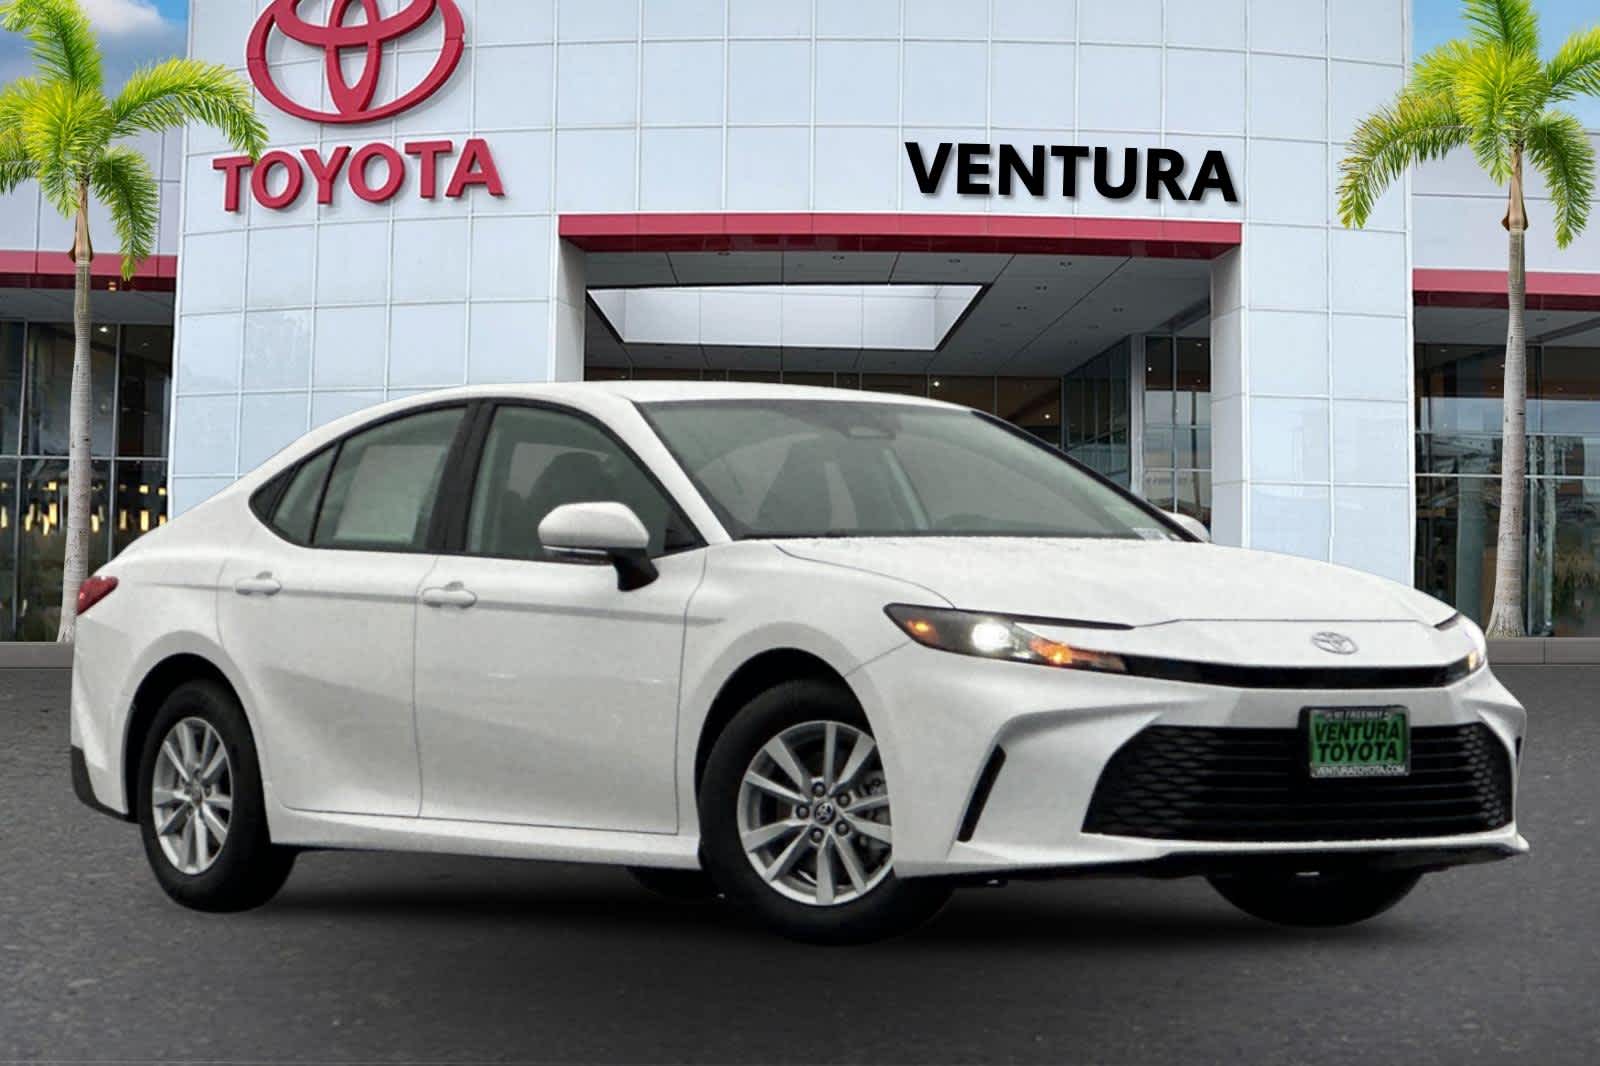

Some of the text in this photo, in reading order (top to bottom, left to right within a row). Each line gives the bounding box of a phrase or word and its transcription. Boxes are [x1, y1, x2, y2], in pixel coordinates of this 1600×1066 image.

[213, 139, 505, 213] TOYOTA
[905, 142, 1238, 203] VENTURA
[1315, 722, 1400, 742] VENTURA
[1317, 742, 1398, 762] TOYOTA
